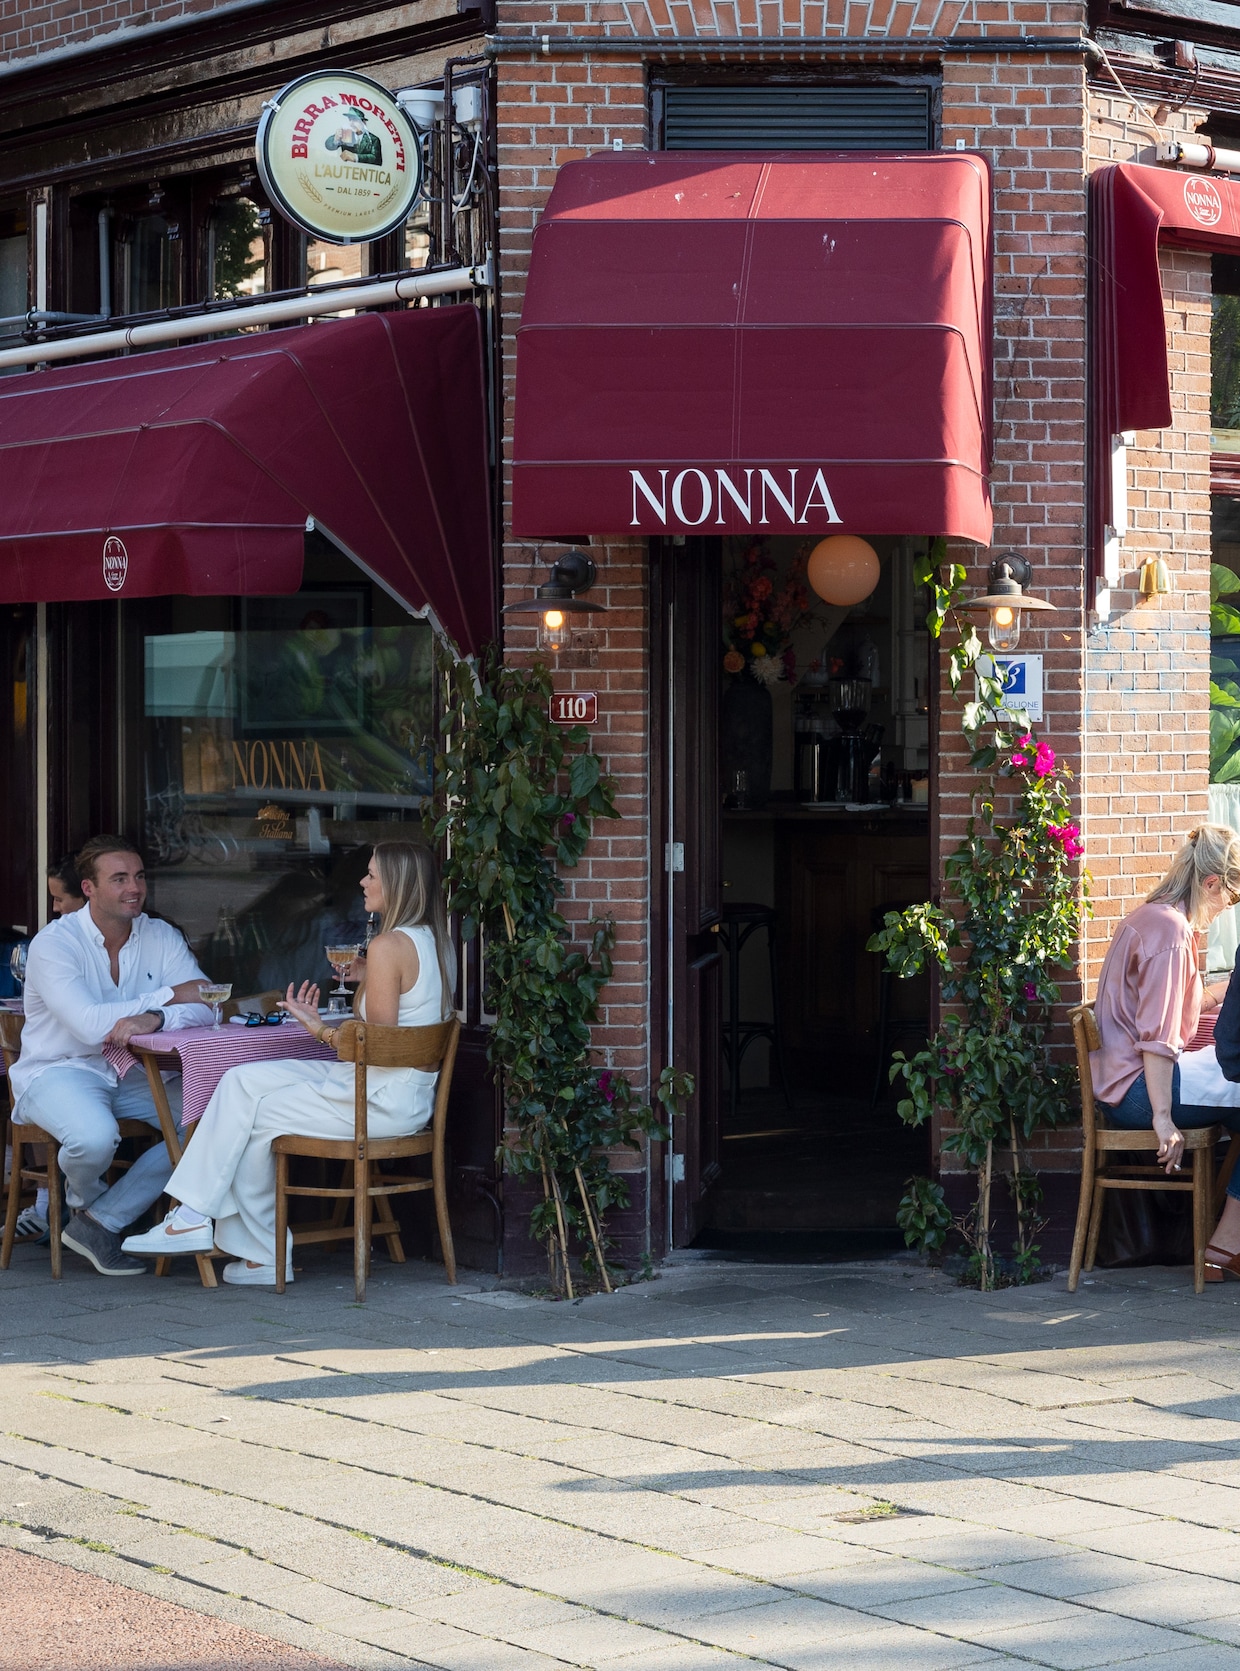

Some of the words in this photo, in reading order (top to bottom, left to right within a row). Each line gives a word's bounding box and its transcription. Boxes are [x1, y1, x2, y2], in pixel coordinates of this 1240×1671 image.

[291, 95, 339, 159] BIRRA
[338, 93, 406, 172] MORETTI
[314, 164, 391, 186] L'AUTENTICA
[337, 186, 352, 195] DAL
[354, 188, 371, 197] 1859
[1186, 191, 1220, 209] NONNA
[628, 467, 844, 526] NONNA
[558, 697, 587, 719] 110
[231, 740, 328, 792] NONNA
